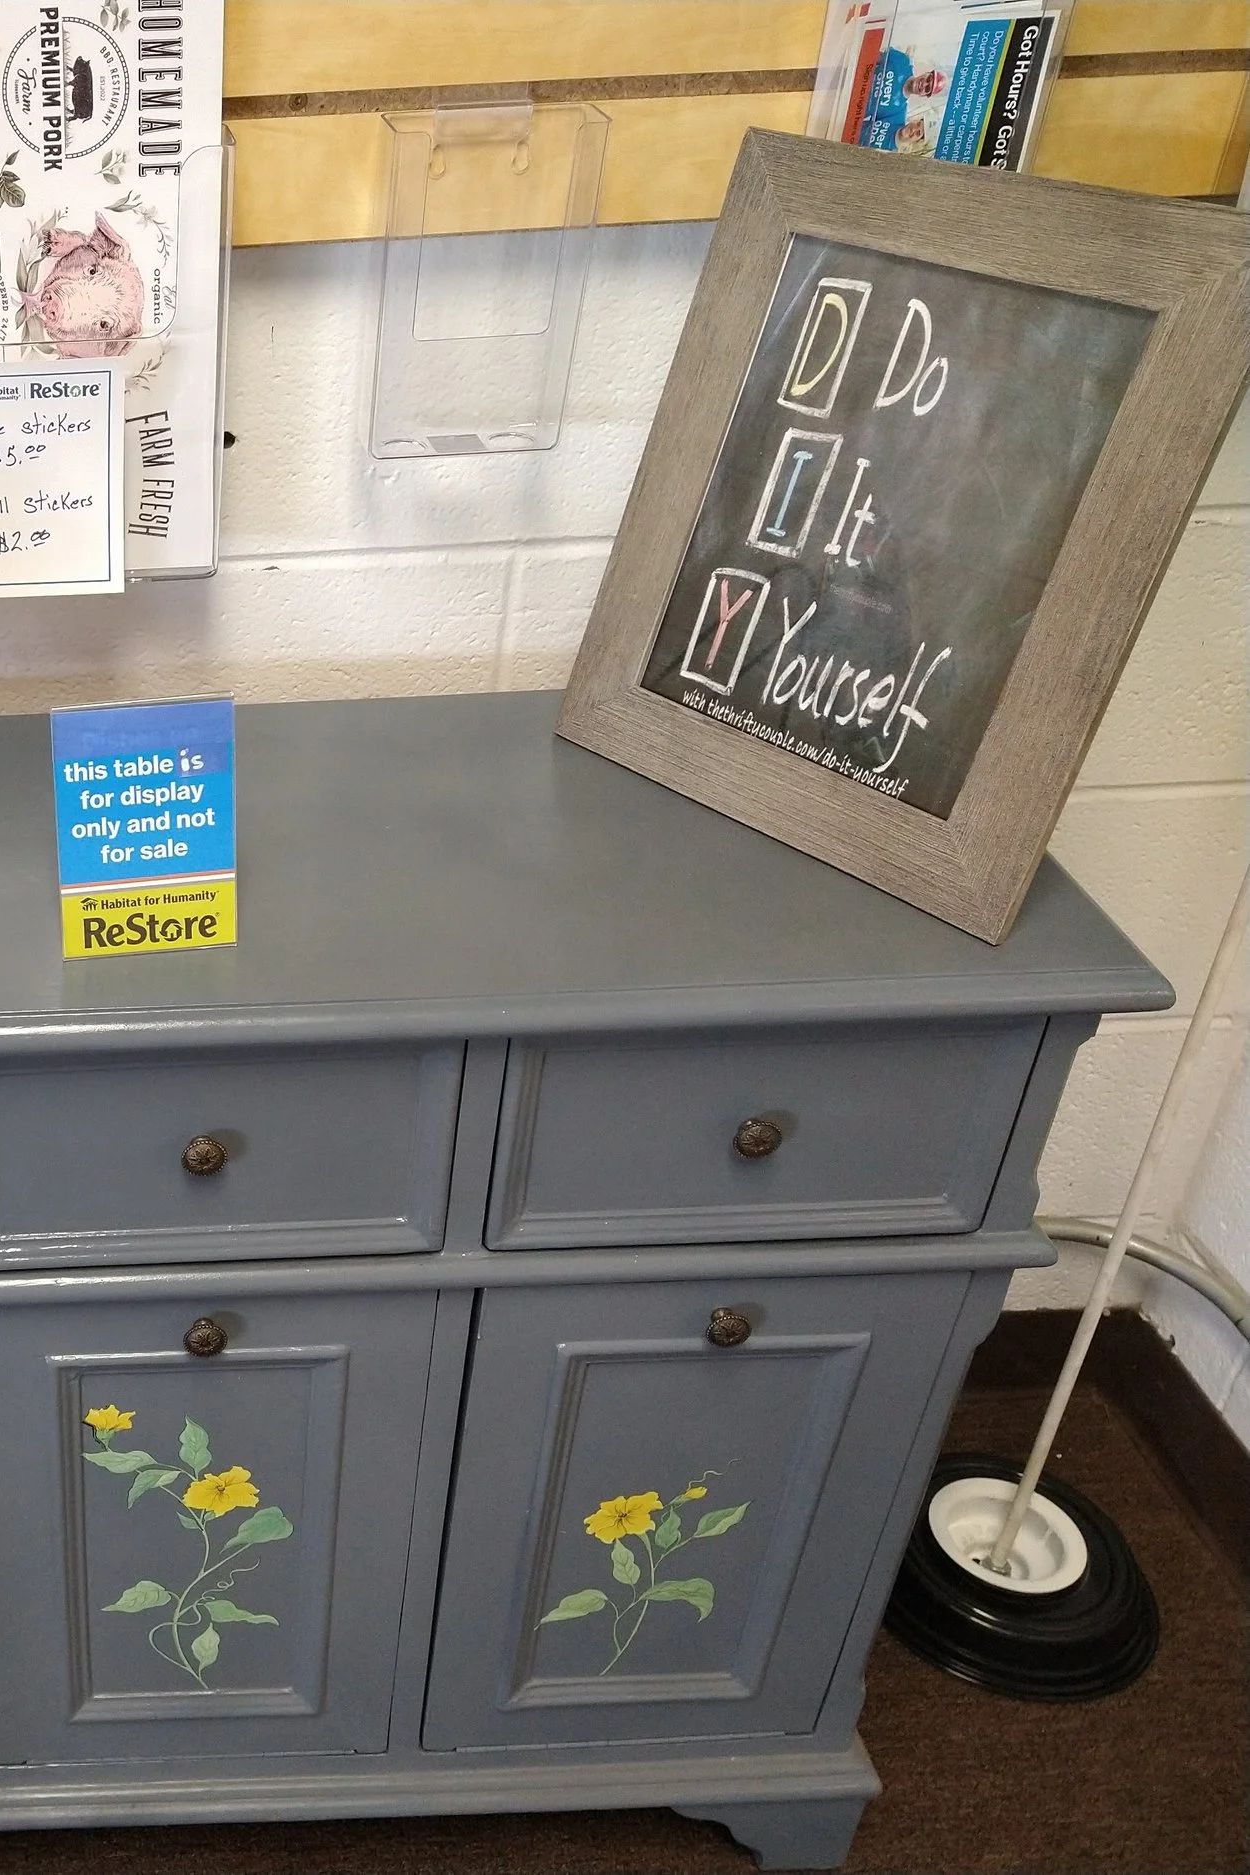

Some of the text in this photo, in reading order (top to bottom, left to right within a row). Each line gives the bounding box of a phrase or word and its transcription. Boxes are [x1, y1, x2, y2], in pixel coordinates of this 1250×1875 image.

[965, 33, 980, 56] Time
[979, 31, 990, 62] court?
[992, 30, 1005, 46] Do
[1018, 25, 1039, 58] Got
[962, 56, 971, 66] to
[987, 46, 998, 64] you
[17, 67, 37, 115] Farm
[39, 6, 63, 173] PREMIUM PORK
[137, 0, 185, 178] HOMEMADE
[880, 70, 894, 107] every
[958, 66, 968, 87] give
[964, 63, 983, 115] Handyman
[981, 63, 994, 86] have
[1003, 60, 1031, 120] Hours?
[101, 67, 120, 127] RESTAURANT
[953, 86, 966, 109] back
[971, 87, 988, 129] volunteer
[943, 126, 956, 145] little
[960, 114, 969, 124] or
[942, 144, 950, 156] or
[963, 128, 978, 156] hours
[993, 125, 1013, 158] Got
[152, 268, 164, 325] organic
[789, 292, 949, 416] D Do
[30, 381, 100, 399] ReStore
[125, 410, 175, 538] FARM FRESH
[765, 450, 877, 568] I It
[703, 578, 952, 772] Y Yourself
[682, 688, 909, 800] with thethriftycouple.com/do-it-yourself
[63, 748, 205, 783] this table is
[79, 782, 205, 810] for display
[71, 807, 216, 840] only and not
[100, 838, 189, 864] for sale
[100, 890, 217, 910] Habitat for Humanity
[83, 913, 218, 949] ReStore
